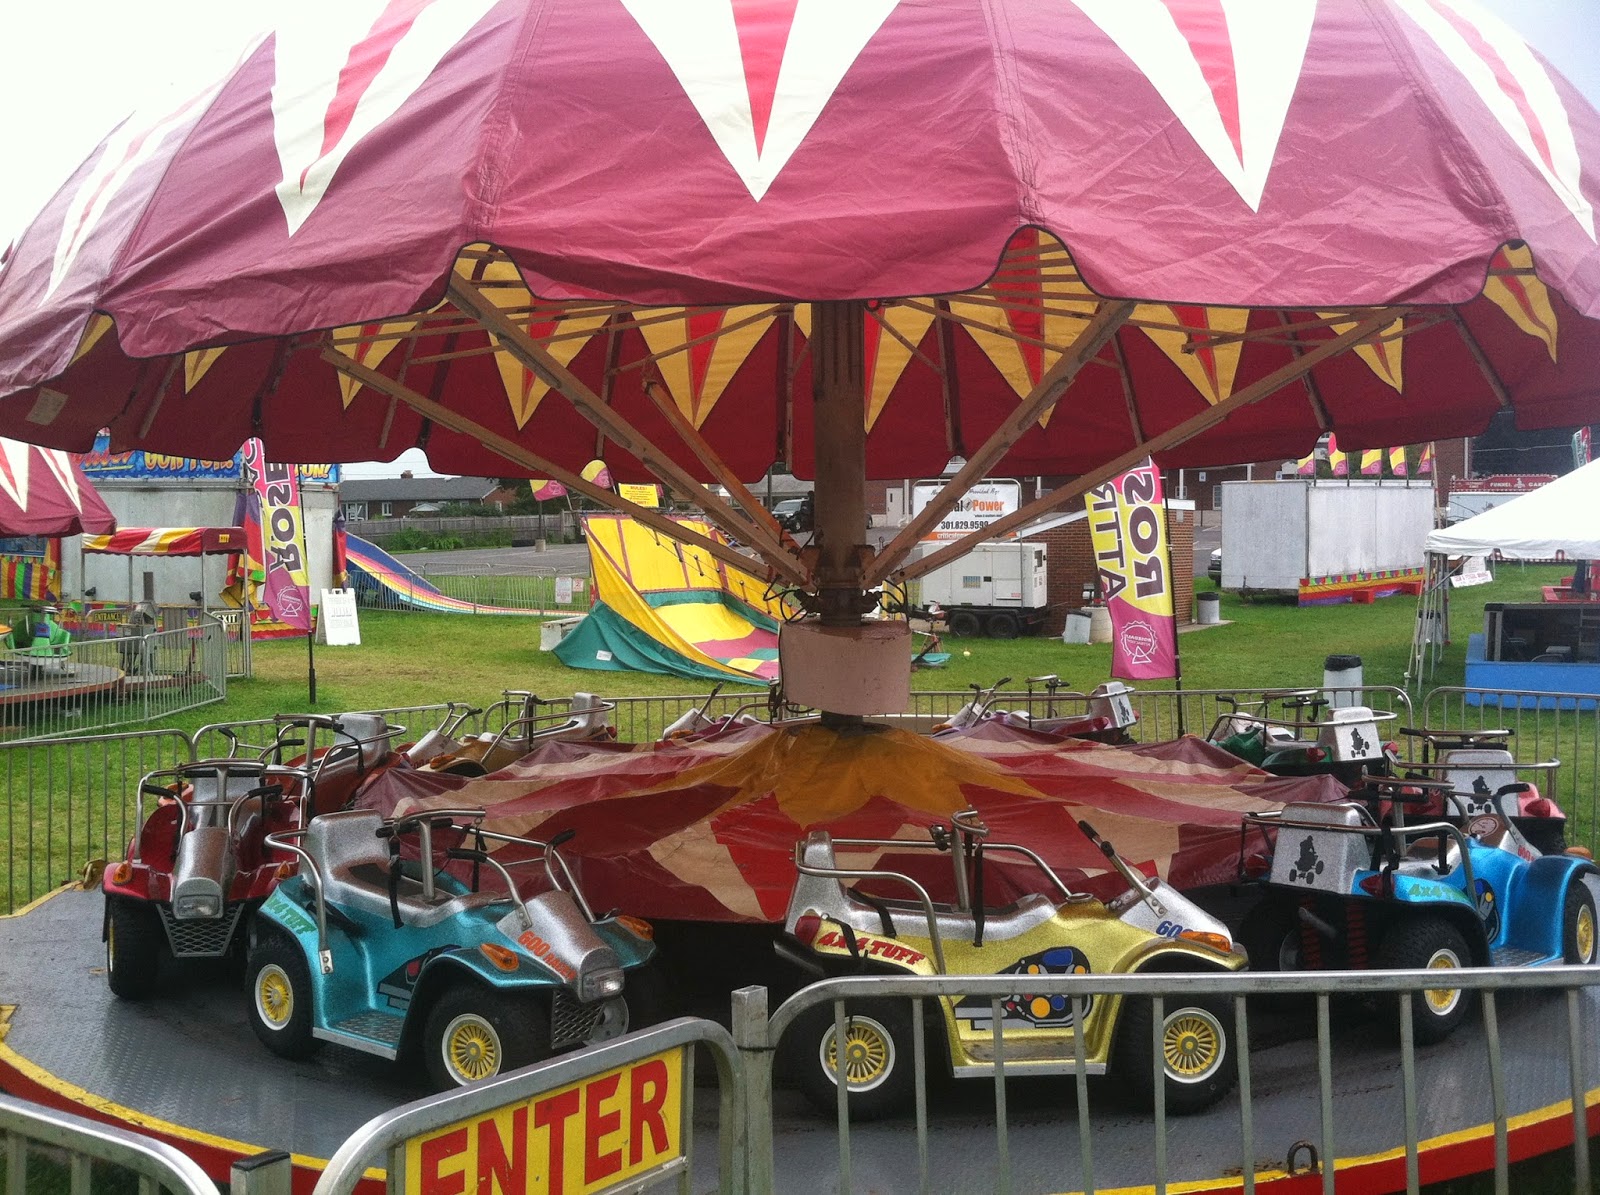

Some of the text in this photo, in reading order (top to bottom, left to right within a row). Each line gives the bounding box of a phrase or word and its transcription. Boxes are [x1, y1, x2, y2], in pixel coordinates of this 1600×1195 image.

[972, 499, 1004, 511] Power
[518, 930, 551, 957] 600
[868, 940, 926, 966] TUFF
[420, 1059, 670, 1195] ENTER
